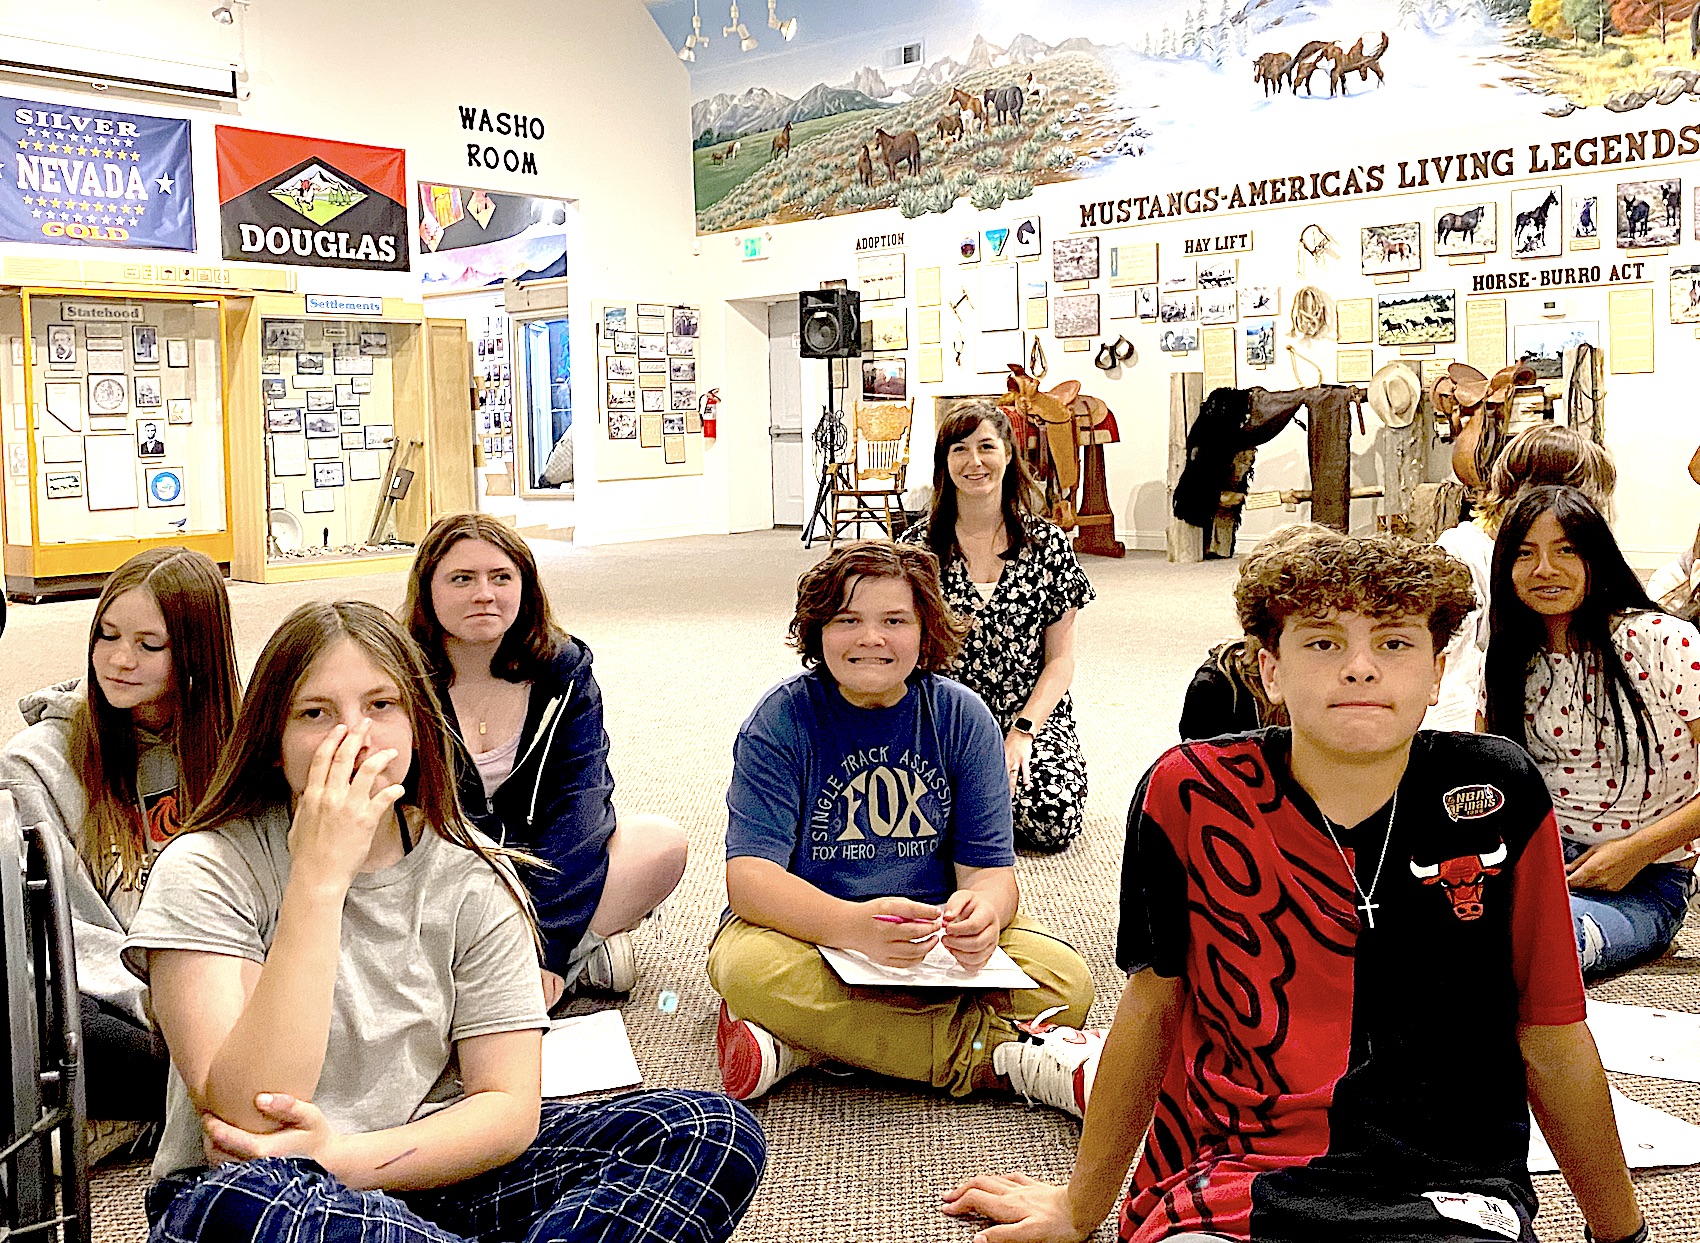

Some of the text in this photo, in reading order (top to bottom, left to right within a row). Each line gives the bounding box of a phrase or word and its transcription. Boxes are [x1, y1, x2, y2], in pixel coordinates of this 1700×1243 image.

[15, 107, 141, 138] SILVER
[458, 105, 545, 140] WASHO
[466, 143, 538, 176] ROOM
[15, 153, 149, 200] NEVADA
[1080, 123, 1700, 228] MUSTANGS-AMERICA'S LIVING LEGENDS
[41, 221, 130, 242] GOLD
[239, 223, 396, 262] DOUGLAS
[855, 232, 905, 251] ADOPTION
[1184, 233, 1248, 255] HAY LIFT
[1472, 263, 1645, 291] HORSE-BURRO ACT
[66, 305, 140, 320] Statehood
[309, 298, 381, 312] Settlements
[811, 775, 843, 842] SINGLE
[841, 746, 889, 776] TRACK
[836, 766, 938, 841] FOX
[1456, 789, 1485, 803] NBA
[1456, 798, 1496, 812] Finals
[812, 845, 838, 860] FOX
[842, 844, 876, 860] HERO
[897, 840, 927, 858] DIRT
